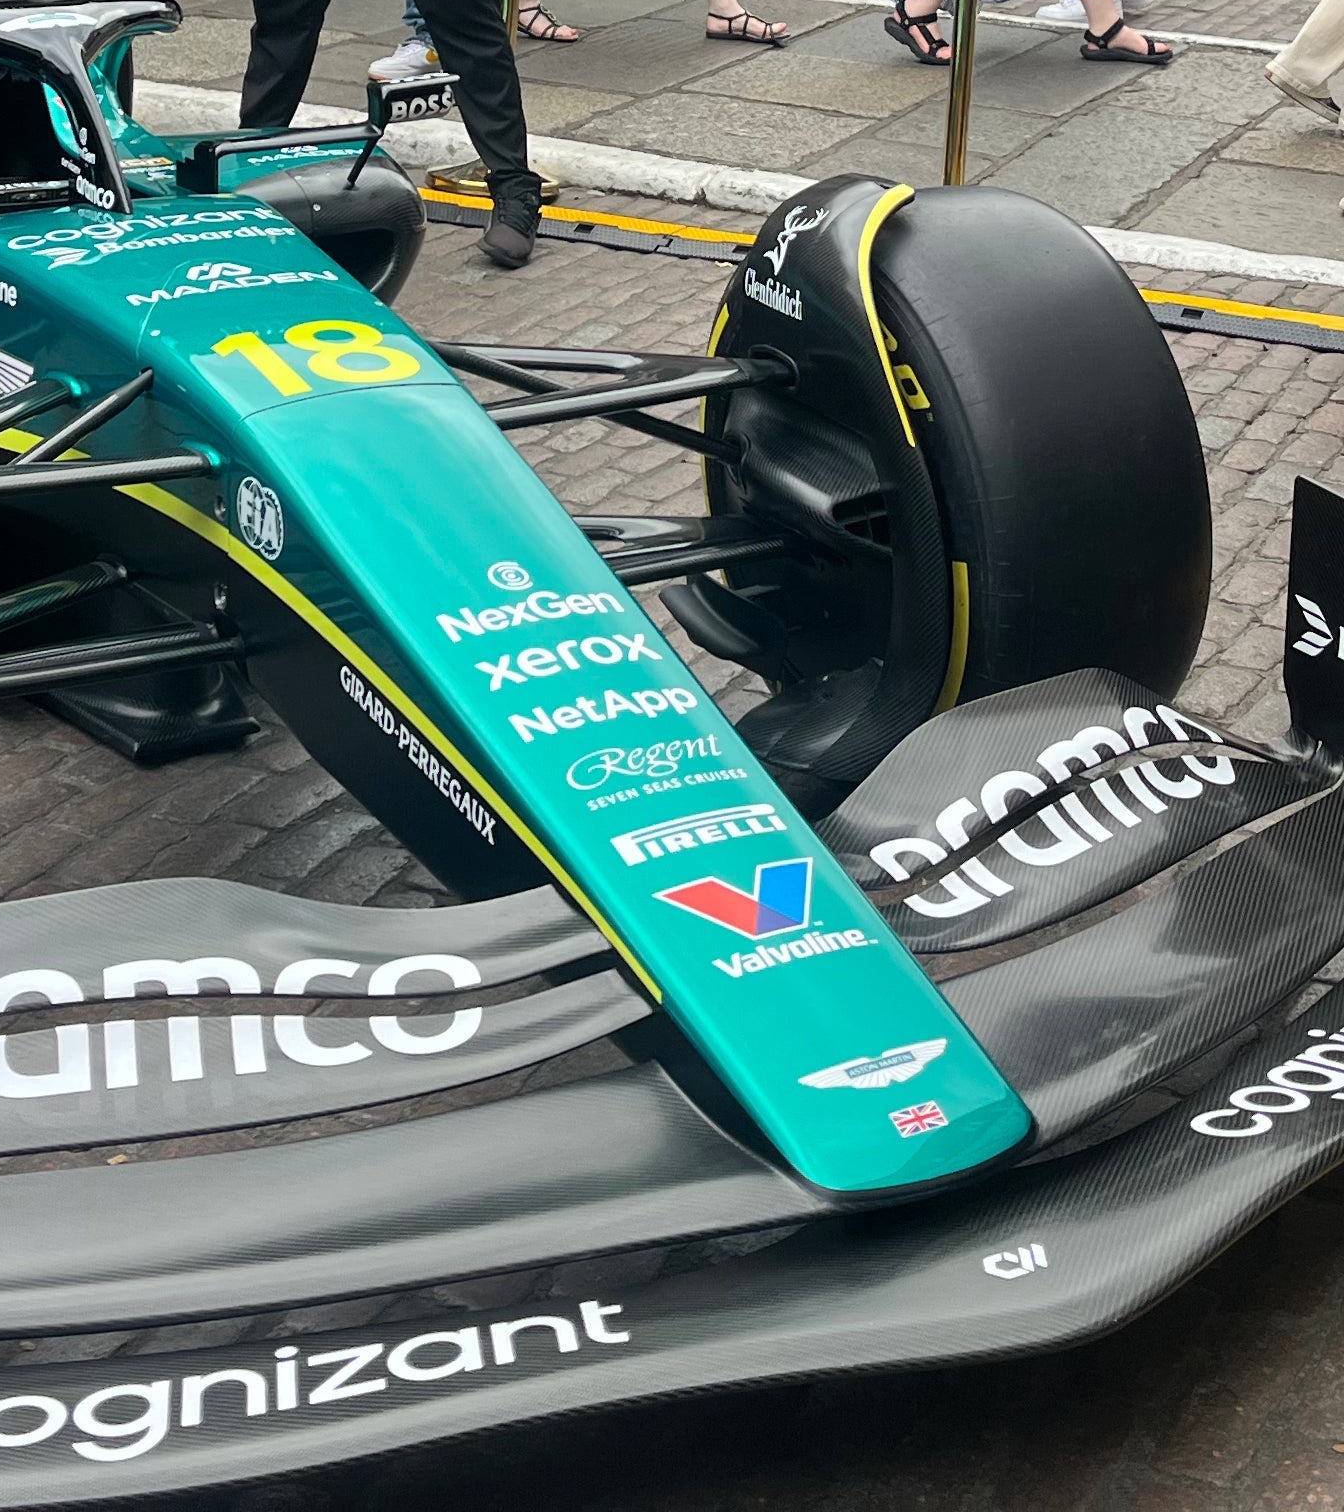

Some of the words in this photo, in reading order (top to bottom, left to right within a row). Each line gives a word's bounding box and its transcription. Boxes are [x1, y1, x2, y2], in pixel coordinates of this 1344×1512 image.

[391, 91, 453, 122] BOSS
[7, 207, 284, 250] cognizant
[97, 225, 297, 255] Bombardier
[125, 270, 339, 307] MAADEN
[745, 268, 804, 321] Glenfiddich
[210, 319, 421, 397] 18
[239, 484, 279, 548] FIA
[436, 588, 624, 643] NexGen
[476, 631, 662, 691] xerox
[509, 684, 698, 743] NetApp
[565, 732, 722, 791] Regent
[587, 786, 640, 812] SEVEN
[644, 777, 680, 798] SEAS
[684, 768, 748, 789] CRUISES
[870, 703, 1238, 919] aramco
[610, 804, 787, 866] PIRELLI
[713, 928, 870, 980] Valvoline
[849, 1062, 879, 1077] ASTON
[879, 1054, 913, 1069] MARTIN
